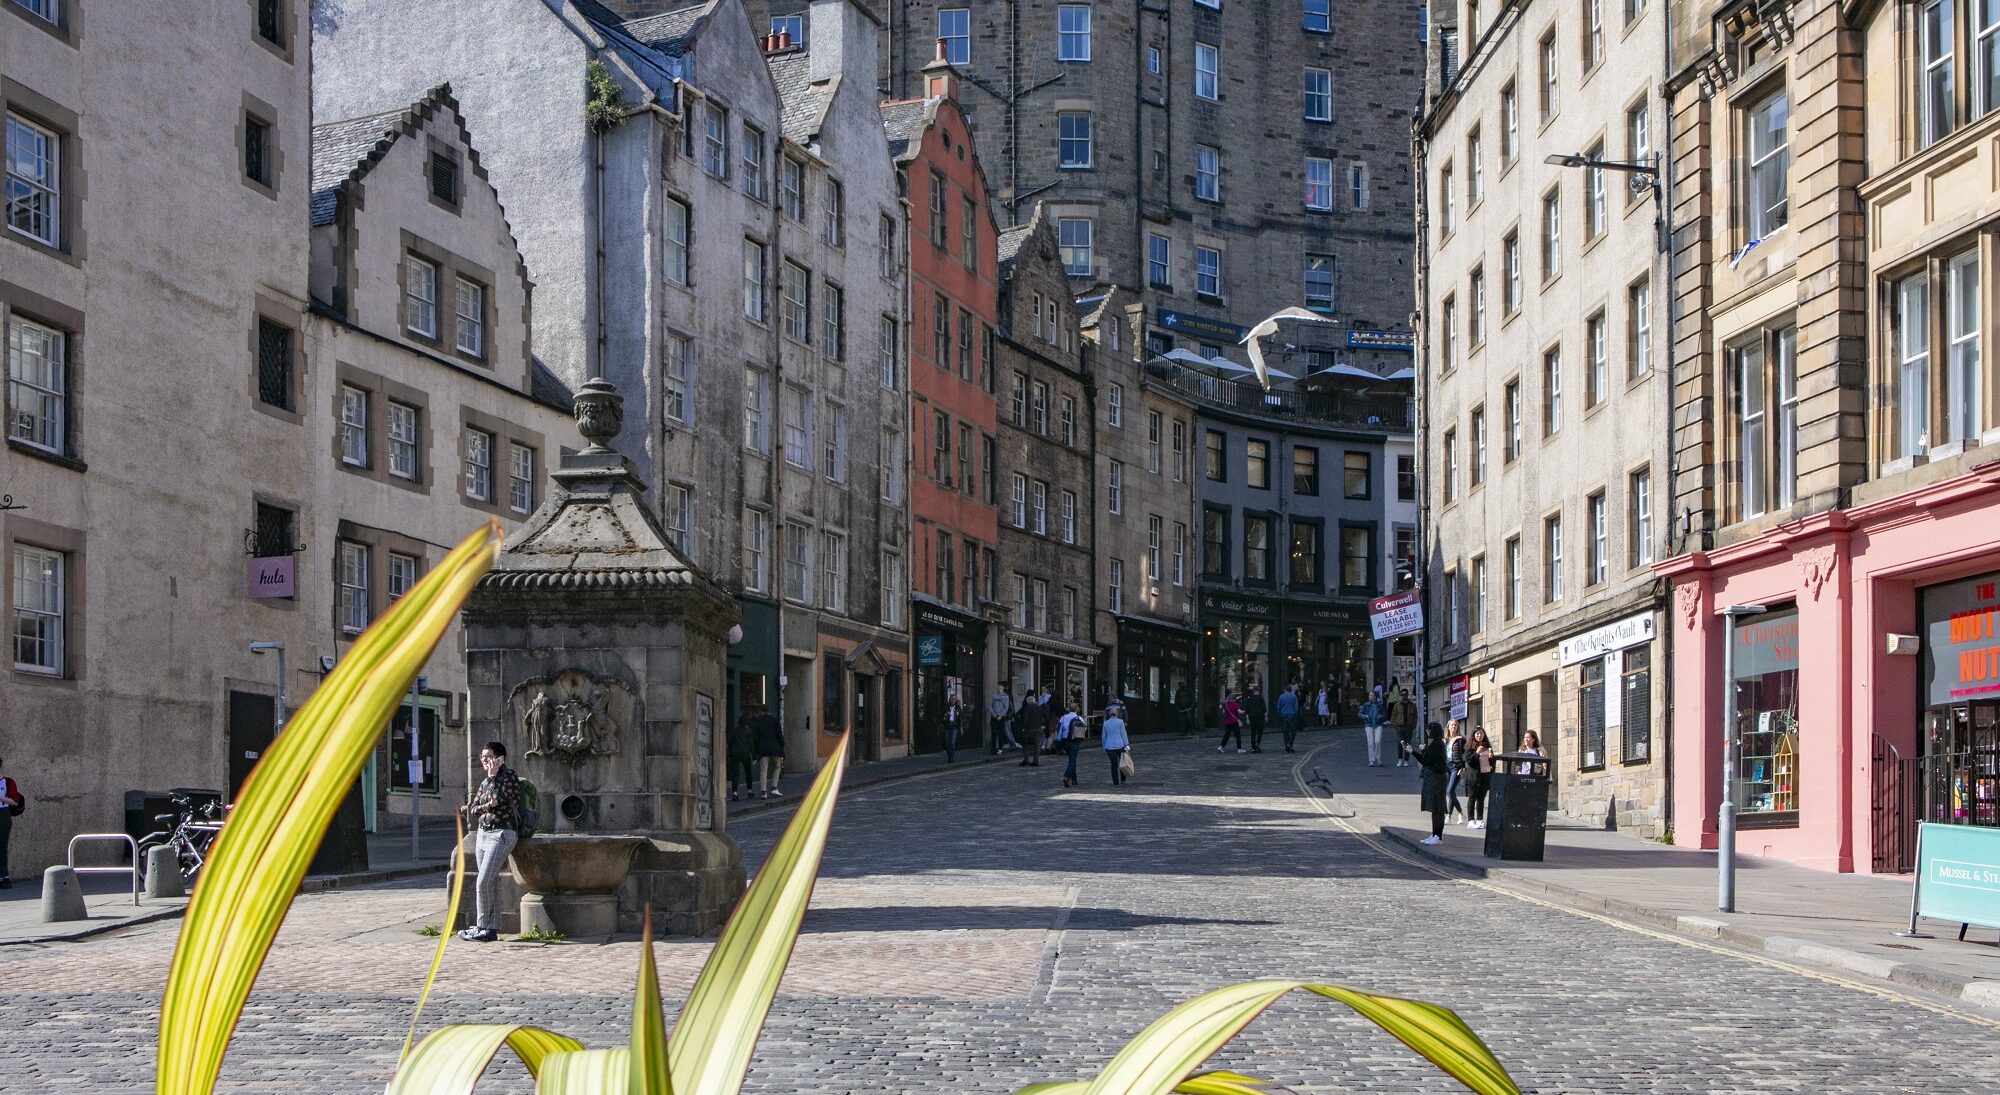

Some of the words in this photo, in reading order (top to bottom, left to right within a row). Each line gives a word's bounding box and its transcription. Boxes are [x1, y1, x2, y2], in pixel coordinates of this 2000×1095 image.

[259, 568, 286, 585] hula
[1976, 582, 1995, 602] THE
[1221, 600, 1244, 611] Walker
[1247, 603, 1269, 614] Slater
[1375, 594, 1413, 610] Culverwell
[1313, 610, 1349, 619] LADIESWEAR
[1377, 612, 1418, 628] AVAILABLE
[1384, 607, 1408, 618] LEASE
[1380, 625, 1394, 634] 0131
[1950, 604, 2000, 643] MUT
[1574, 638, 1587, 654] The
[1588, 629, 1615, 651] Knights
[1615, 621, 1636, 640] Vault
[1741, 622, 1799, 647] Christm
[1939, 865, 1971, 880] MUSSEL
[1974, 870, 1981, 881] &
[1983, 871, 2000, 883] STE
